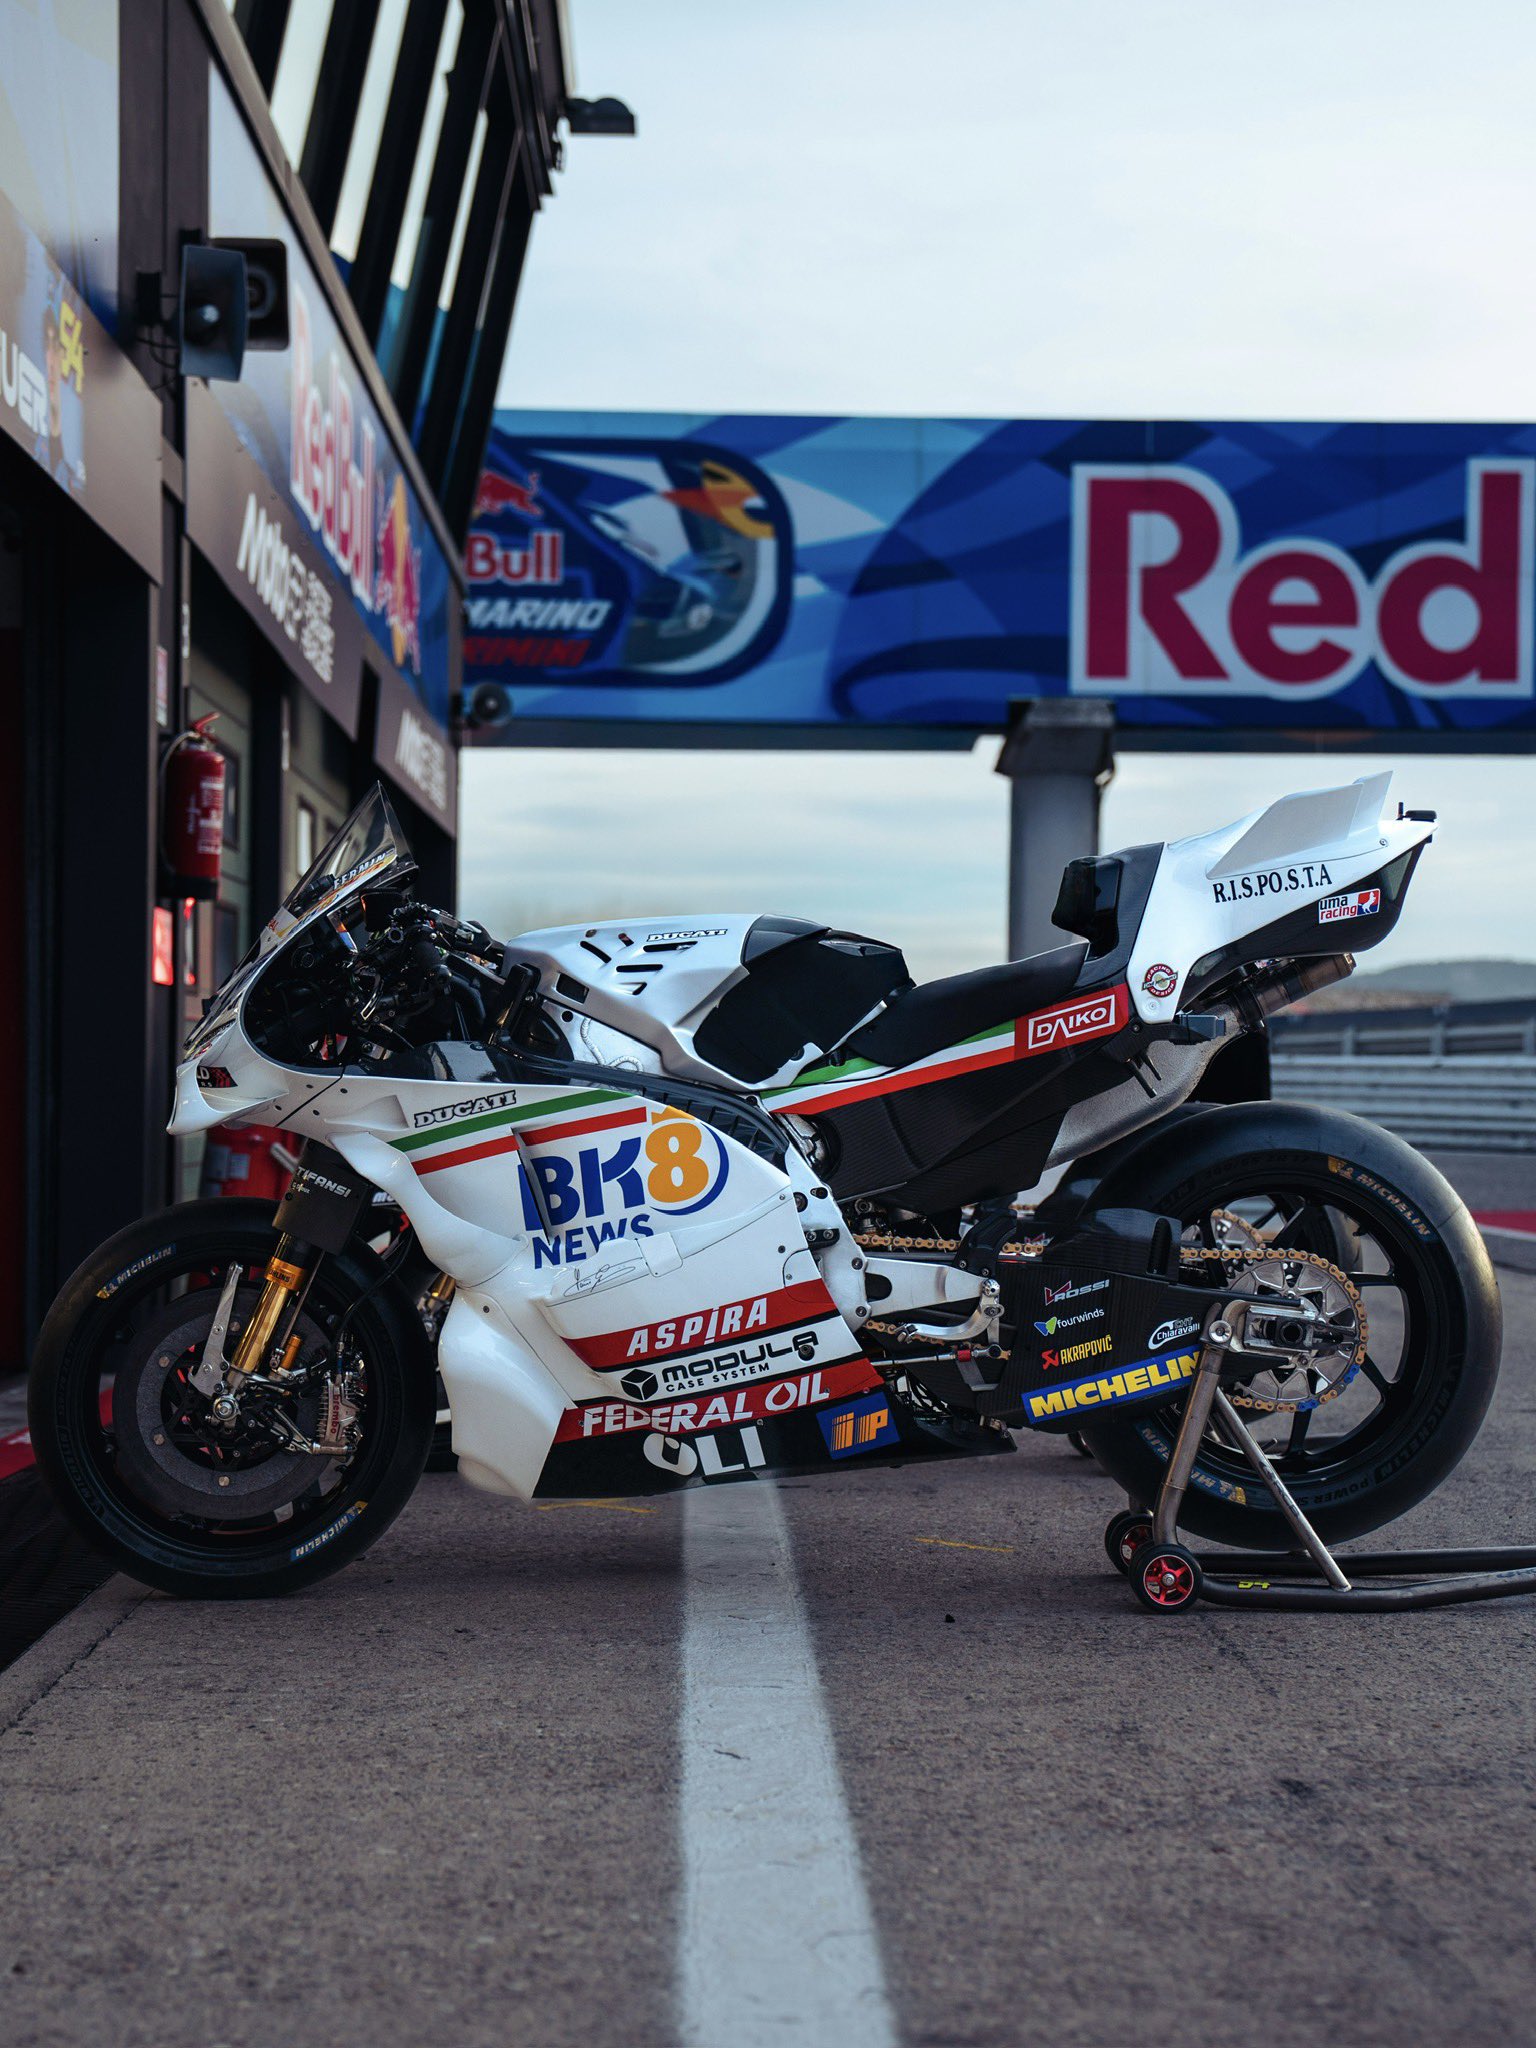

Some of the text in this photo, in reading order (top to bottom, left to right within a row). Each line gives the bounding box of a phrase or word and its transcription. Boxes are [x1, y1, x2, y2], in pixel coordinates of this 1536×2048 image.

[60, 301, 85, 394] 54
[465, 532, 562, 584] Bull
[1070, 458, 1533, 698] Red
[1319, 895, 1349, 911] uma
[1320, 904, 1358, 921] racing
[647, 928, 729, 943] DUCATI
[414, 1089, 517, 1128] DUCATI
[517, 1121, 710, 1232] BK8
[1356, 1173, 1431, 1236] MICHELIN
[116, 1246, 172, 1284] MICHELIN
[532, 1213, 654, 1270] NEWS
[626, 1298, 768, 1357] ASPIRA
[1057, 1308, 1105, 1329] fourwinds
[661, 1330, 819, 1383] MODULA
[666, 1362, 770, 1393] CASE SYSTEM
[330, 1394, 341, 1435] brembo
[583, 1371, 830, 1437] FEDERAL OIL
[295, 1515, 349, 1557] MICHELIN
